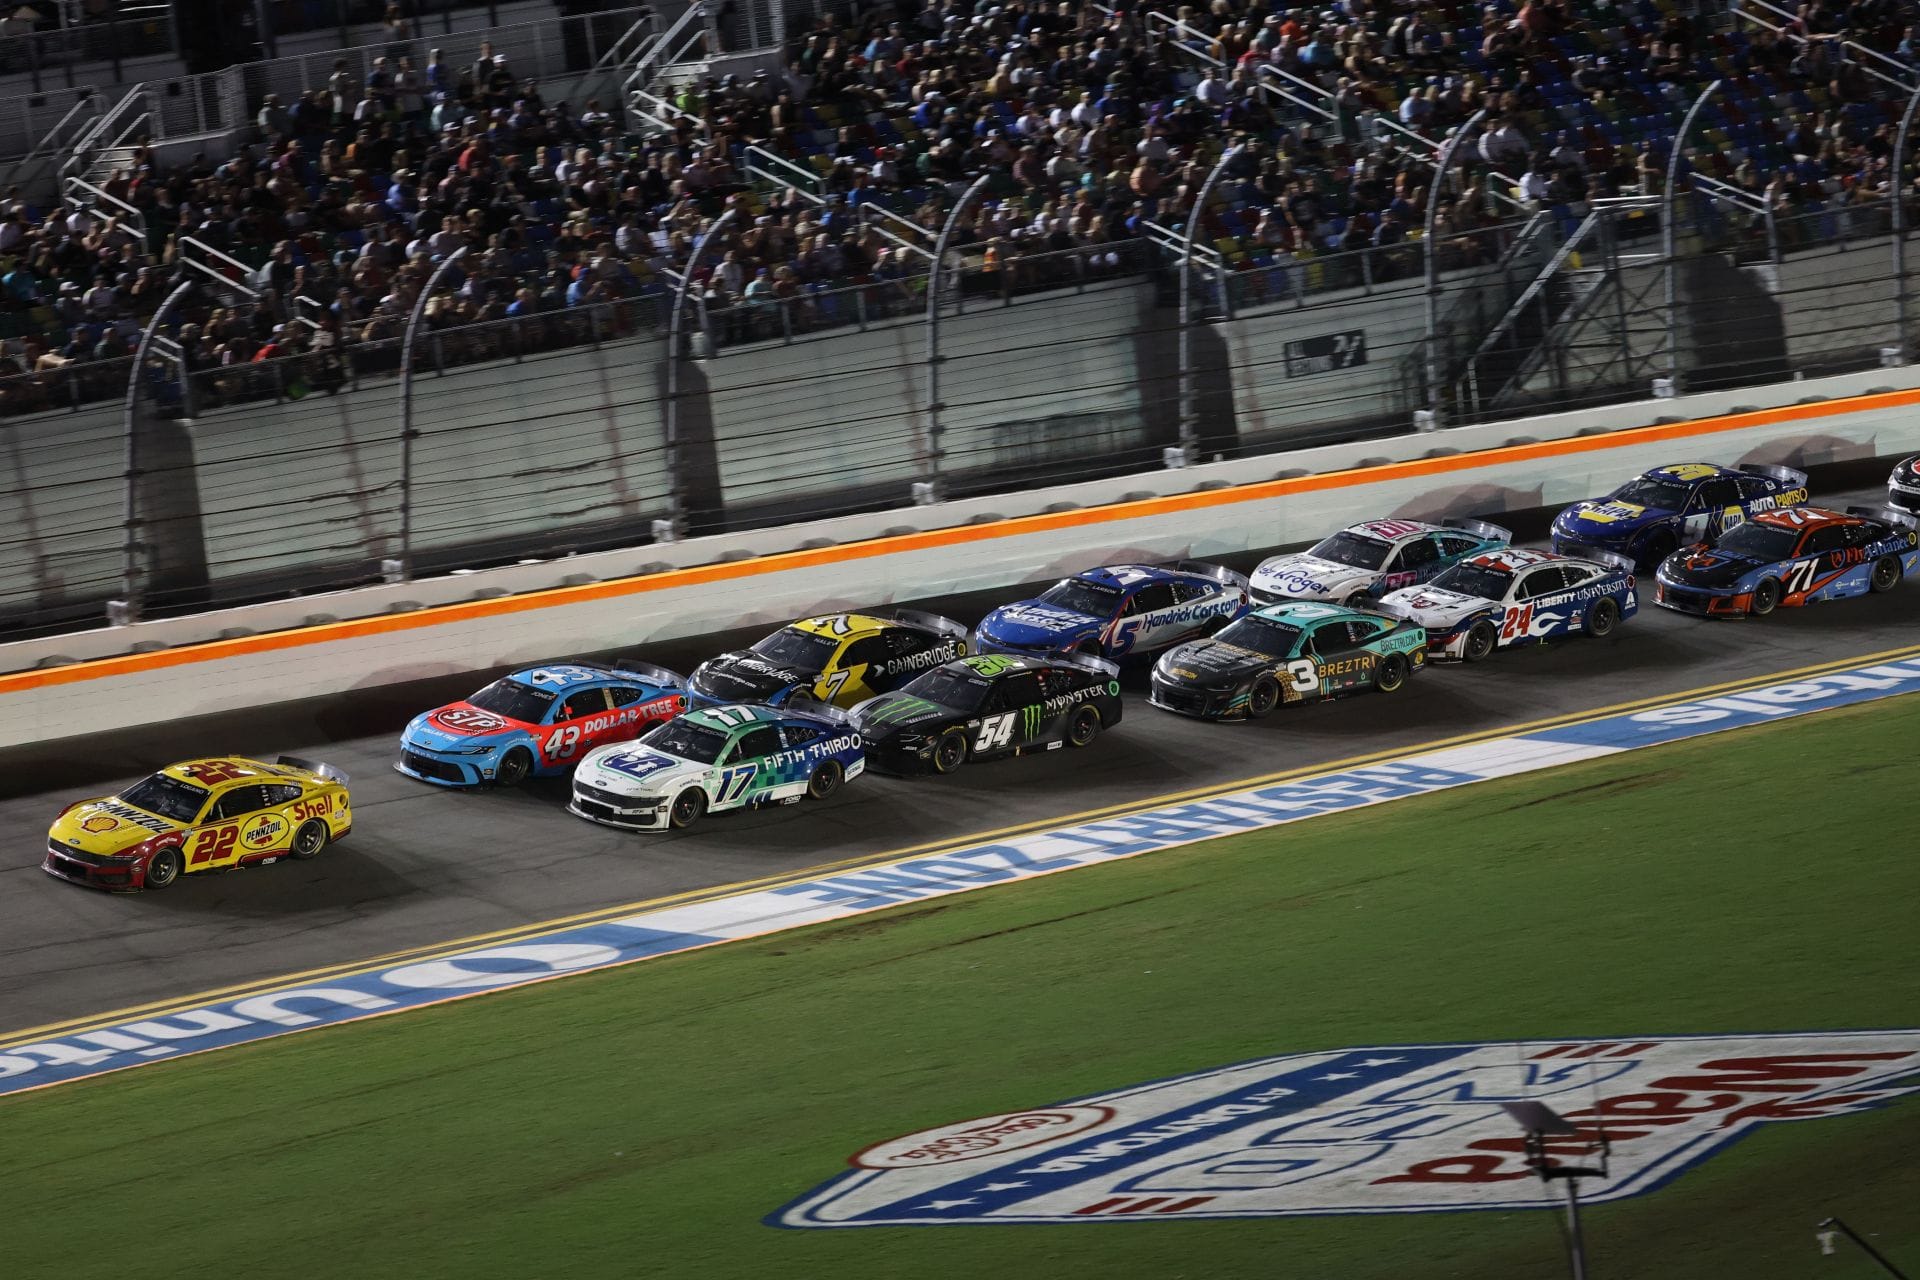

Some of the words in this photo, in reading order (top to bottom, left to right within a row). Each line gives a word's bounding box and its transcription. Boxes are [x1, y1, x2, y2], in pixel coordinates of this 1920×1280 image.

[1750, 496, 1775, 513] AUTO
[1775, 489, 1800, 508] PARTS
[1724, 513, 1743, 530] NAPA
[1772, 509, 1829, 525] 71
[1091, 585, 1117, 595] LARSON
[1274, 570, 1331, 595] Kroger
[1788, 558, 1819, 594] 71
[1536, 591, 1577, 609] LIBERTY
[1577, 579, 1628, 600] UNIVERSITY
[1275, 623, 1300, 633] DILLON
[1502, 603, 1533, 639] 24
[814, 637, 837, 647] HALEY
[1109, 619, 1142, 658] 5
[1381, 635, 1416, 652] BREZTRI.COM
[888, 643, 956, 675] GAINBRIDGE
[1319, 655, 1376, 678] BREZTRI
[532, 665, 594, 686] 43
[826, 671, 850, 706] 7
[1287, 659, 1319, 692] 3
[530, 691, 553, 700] JONES
[1045, 684, 1107, 711] MONSTER
[443, 710, 498, 727] STP
[584, 711, 640, 735] DOLLAR
[640, 699, 673, 719] TREE
[700, 705, 757, 727] 17
[545, 726, 580, 760] 43
[975, 711, 1017, 752] 54
[763, 750, 805, 770] FIFTH
[811, 736, 851, 758] THIRD
[188, 761, 254, 786] 22
[712, 763, 758, 807] 17
[180, 783, 205, 794] LOGANO
[294, 795, 333, 822] Shell
[1055, 761, 1484, 856] RESTART
[191, 824, 240, 865] 22
[246, 821, 282, 843] PENNZOIL
[775, 843, 1085, 909] ZONE
[1243, 1087, 1298, 1105] AT
[1107, 1058, 1645, 1195] 250
[1369, 1051, 1919, 1186] Wawa
[888, 1113, 1074, 1160] Coca-Cola
[1015, 1104, 1274, 1174] DAYTONA
